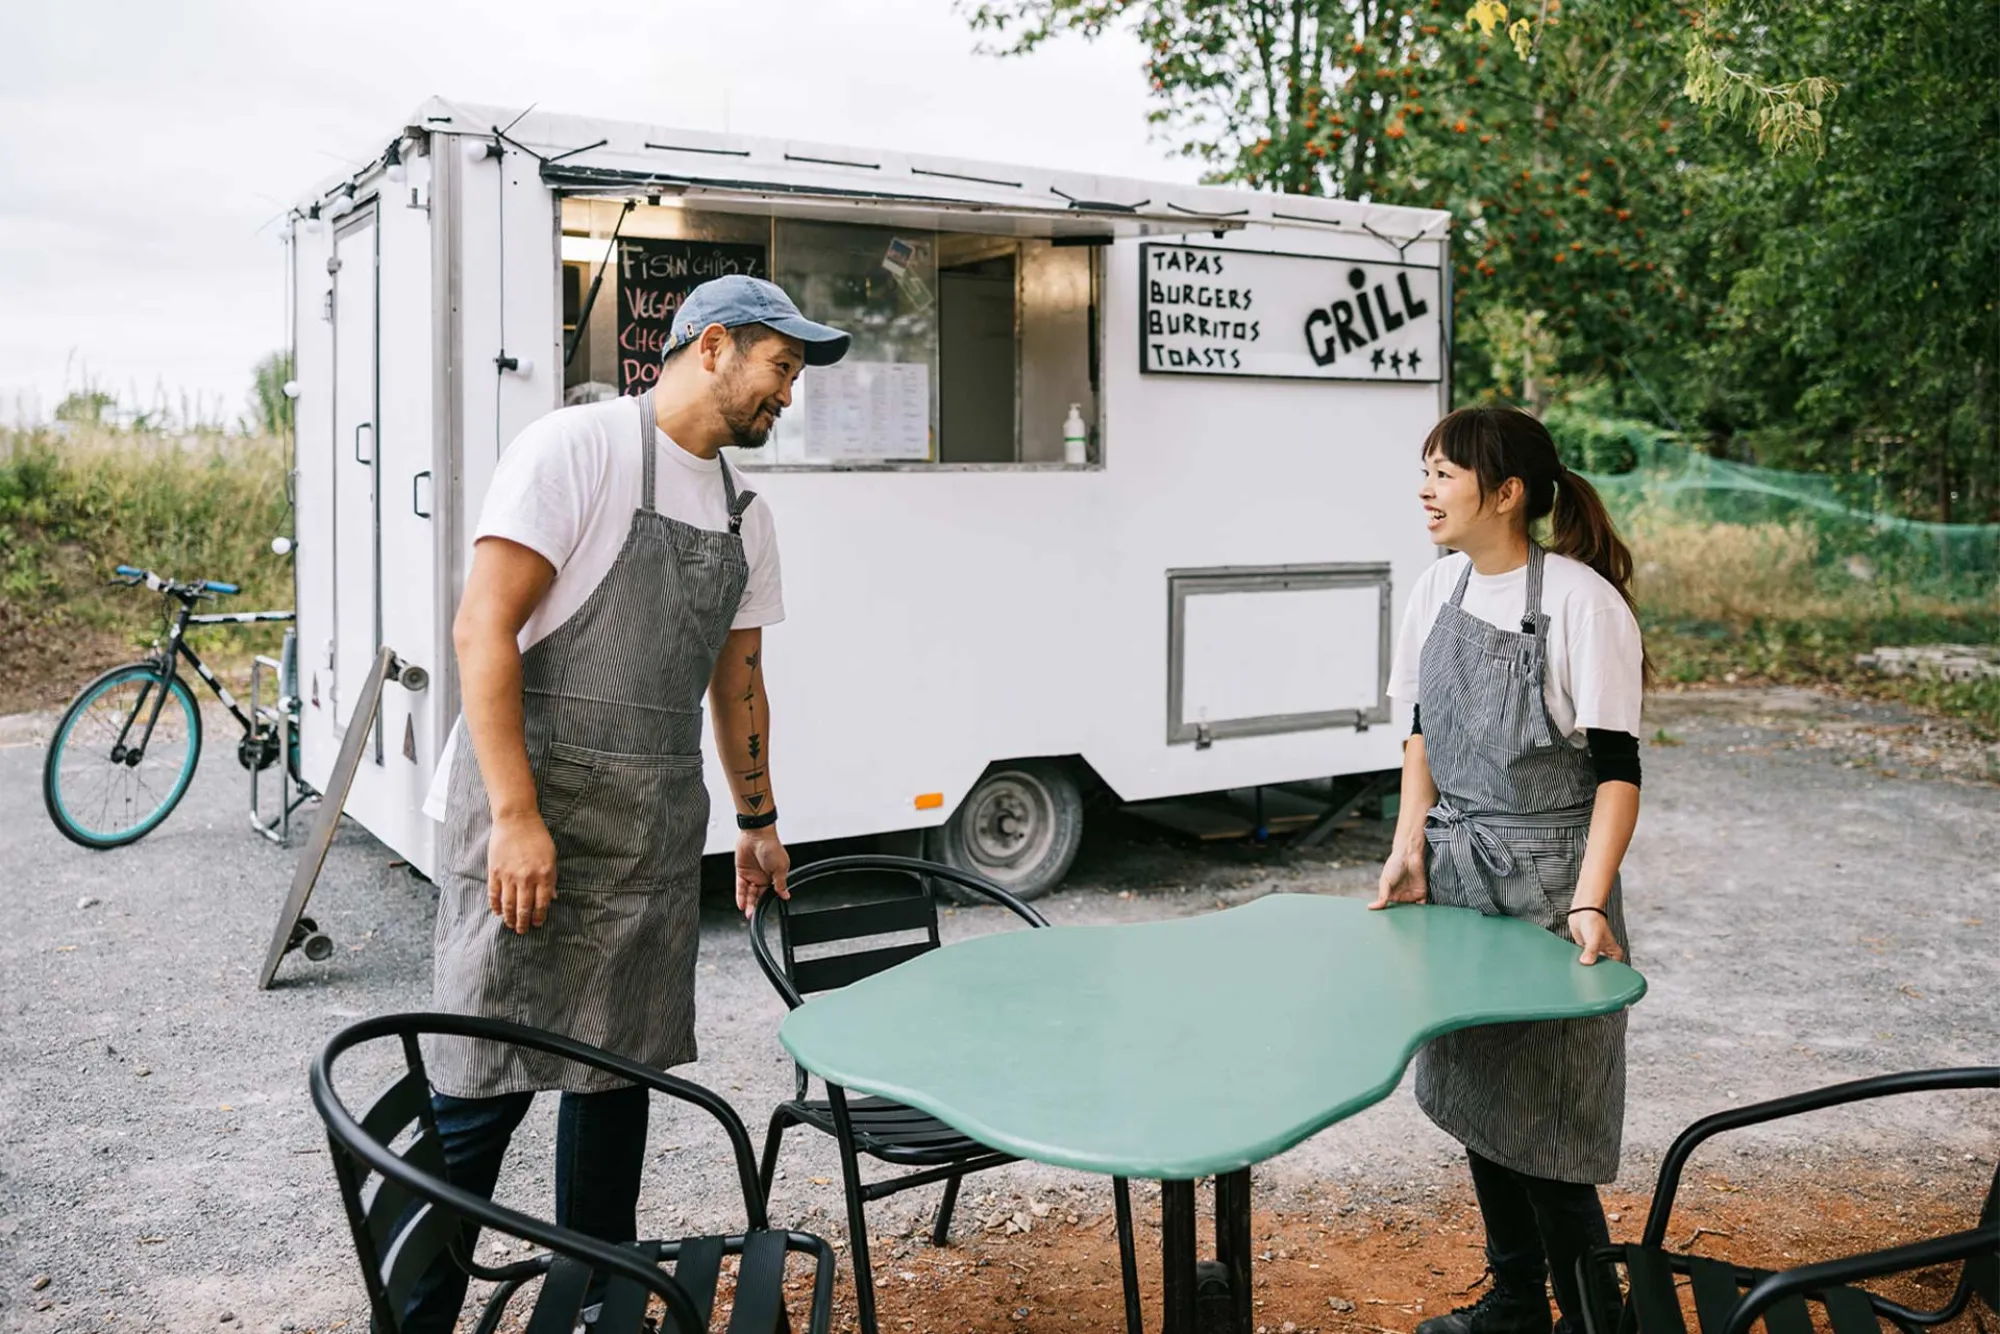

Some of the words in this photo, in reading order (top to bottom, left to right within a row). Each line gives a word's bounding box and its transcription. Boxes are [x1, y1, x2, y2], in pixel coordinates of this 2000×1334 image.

[1152, 251, 1223, 275] TAPAS
[1150, 279, 1252, 311] BURGERS
[1149, 309, 1260, 341] BURRITOS
[1151, 344, 1241, 369] TOASTS
[623, 358, 661, 385] DO
